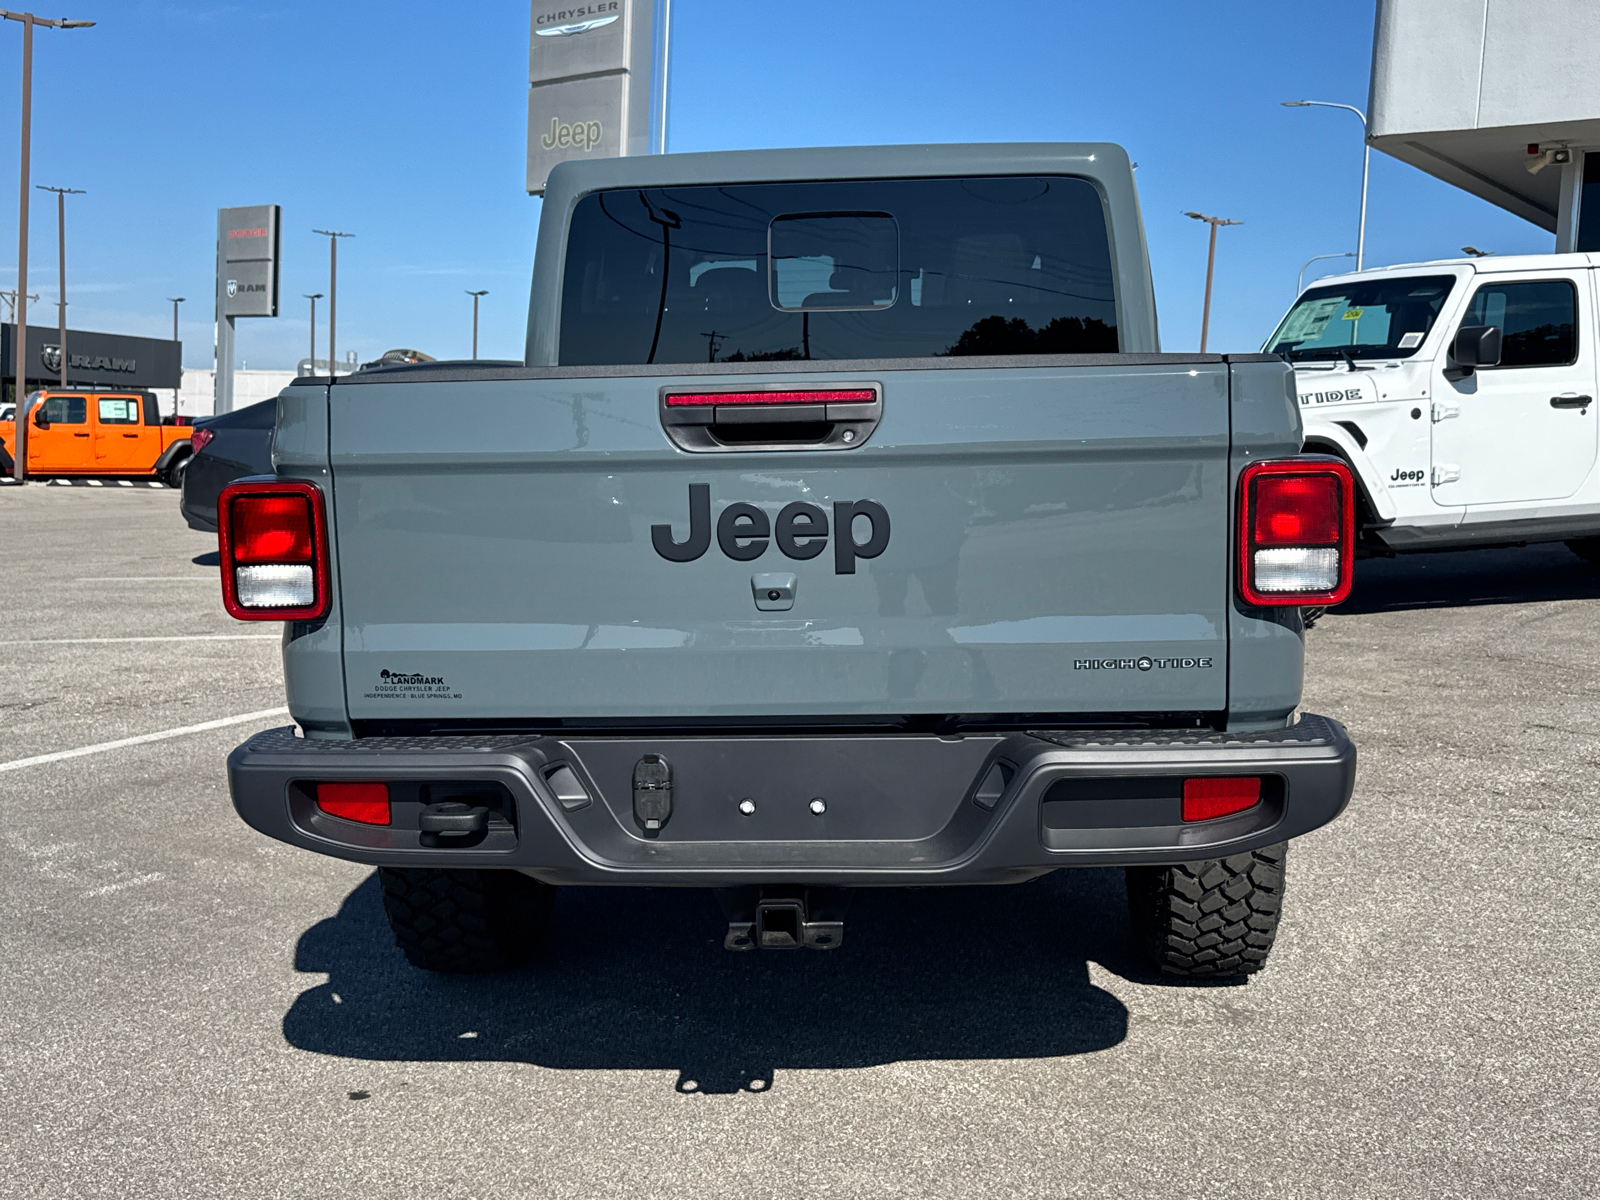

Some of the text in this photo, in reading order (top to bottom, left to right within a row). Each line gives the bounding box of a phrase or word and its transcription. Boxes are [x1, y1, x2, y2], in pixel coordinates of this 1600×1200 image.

[536, 2, 618, 24] CHRYSLER
[542, 117, 602, 152] Jeep
[227, 228, 267, 239] DODGE
[237, 284, 266, 293] RAM
[69, 354, 136, 373] RAM
[1299, 388, 1362, 404] TIDE
[1390, 468, 1425, 482] Jeep
[651, 482, 891, 575] Jeep
[1074, 657, 1213, 670] HIGH TIDE
[391, 677, 444, 685] LANDMARK
